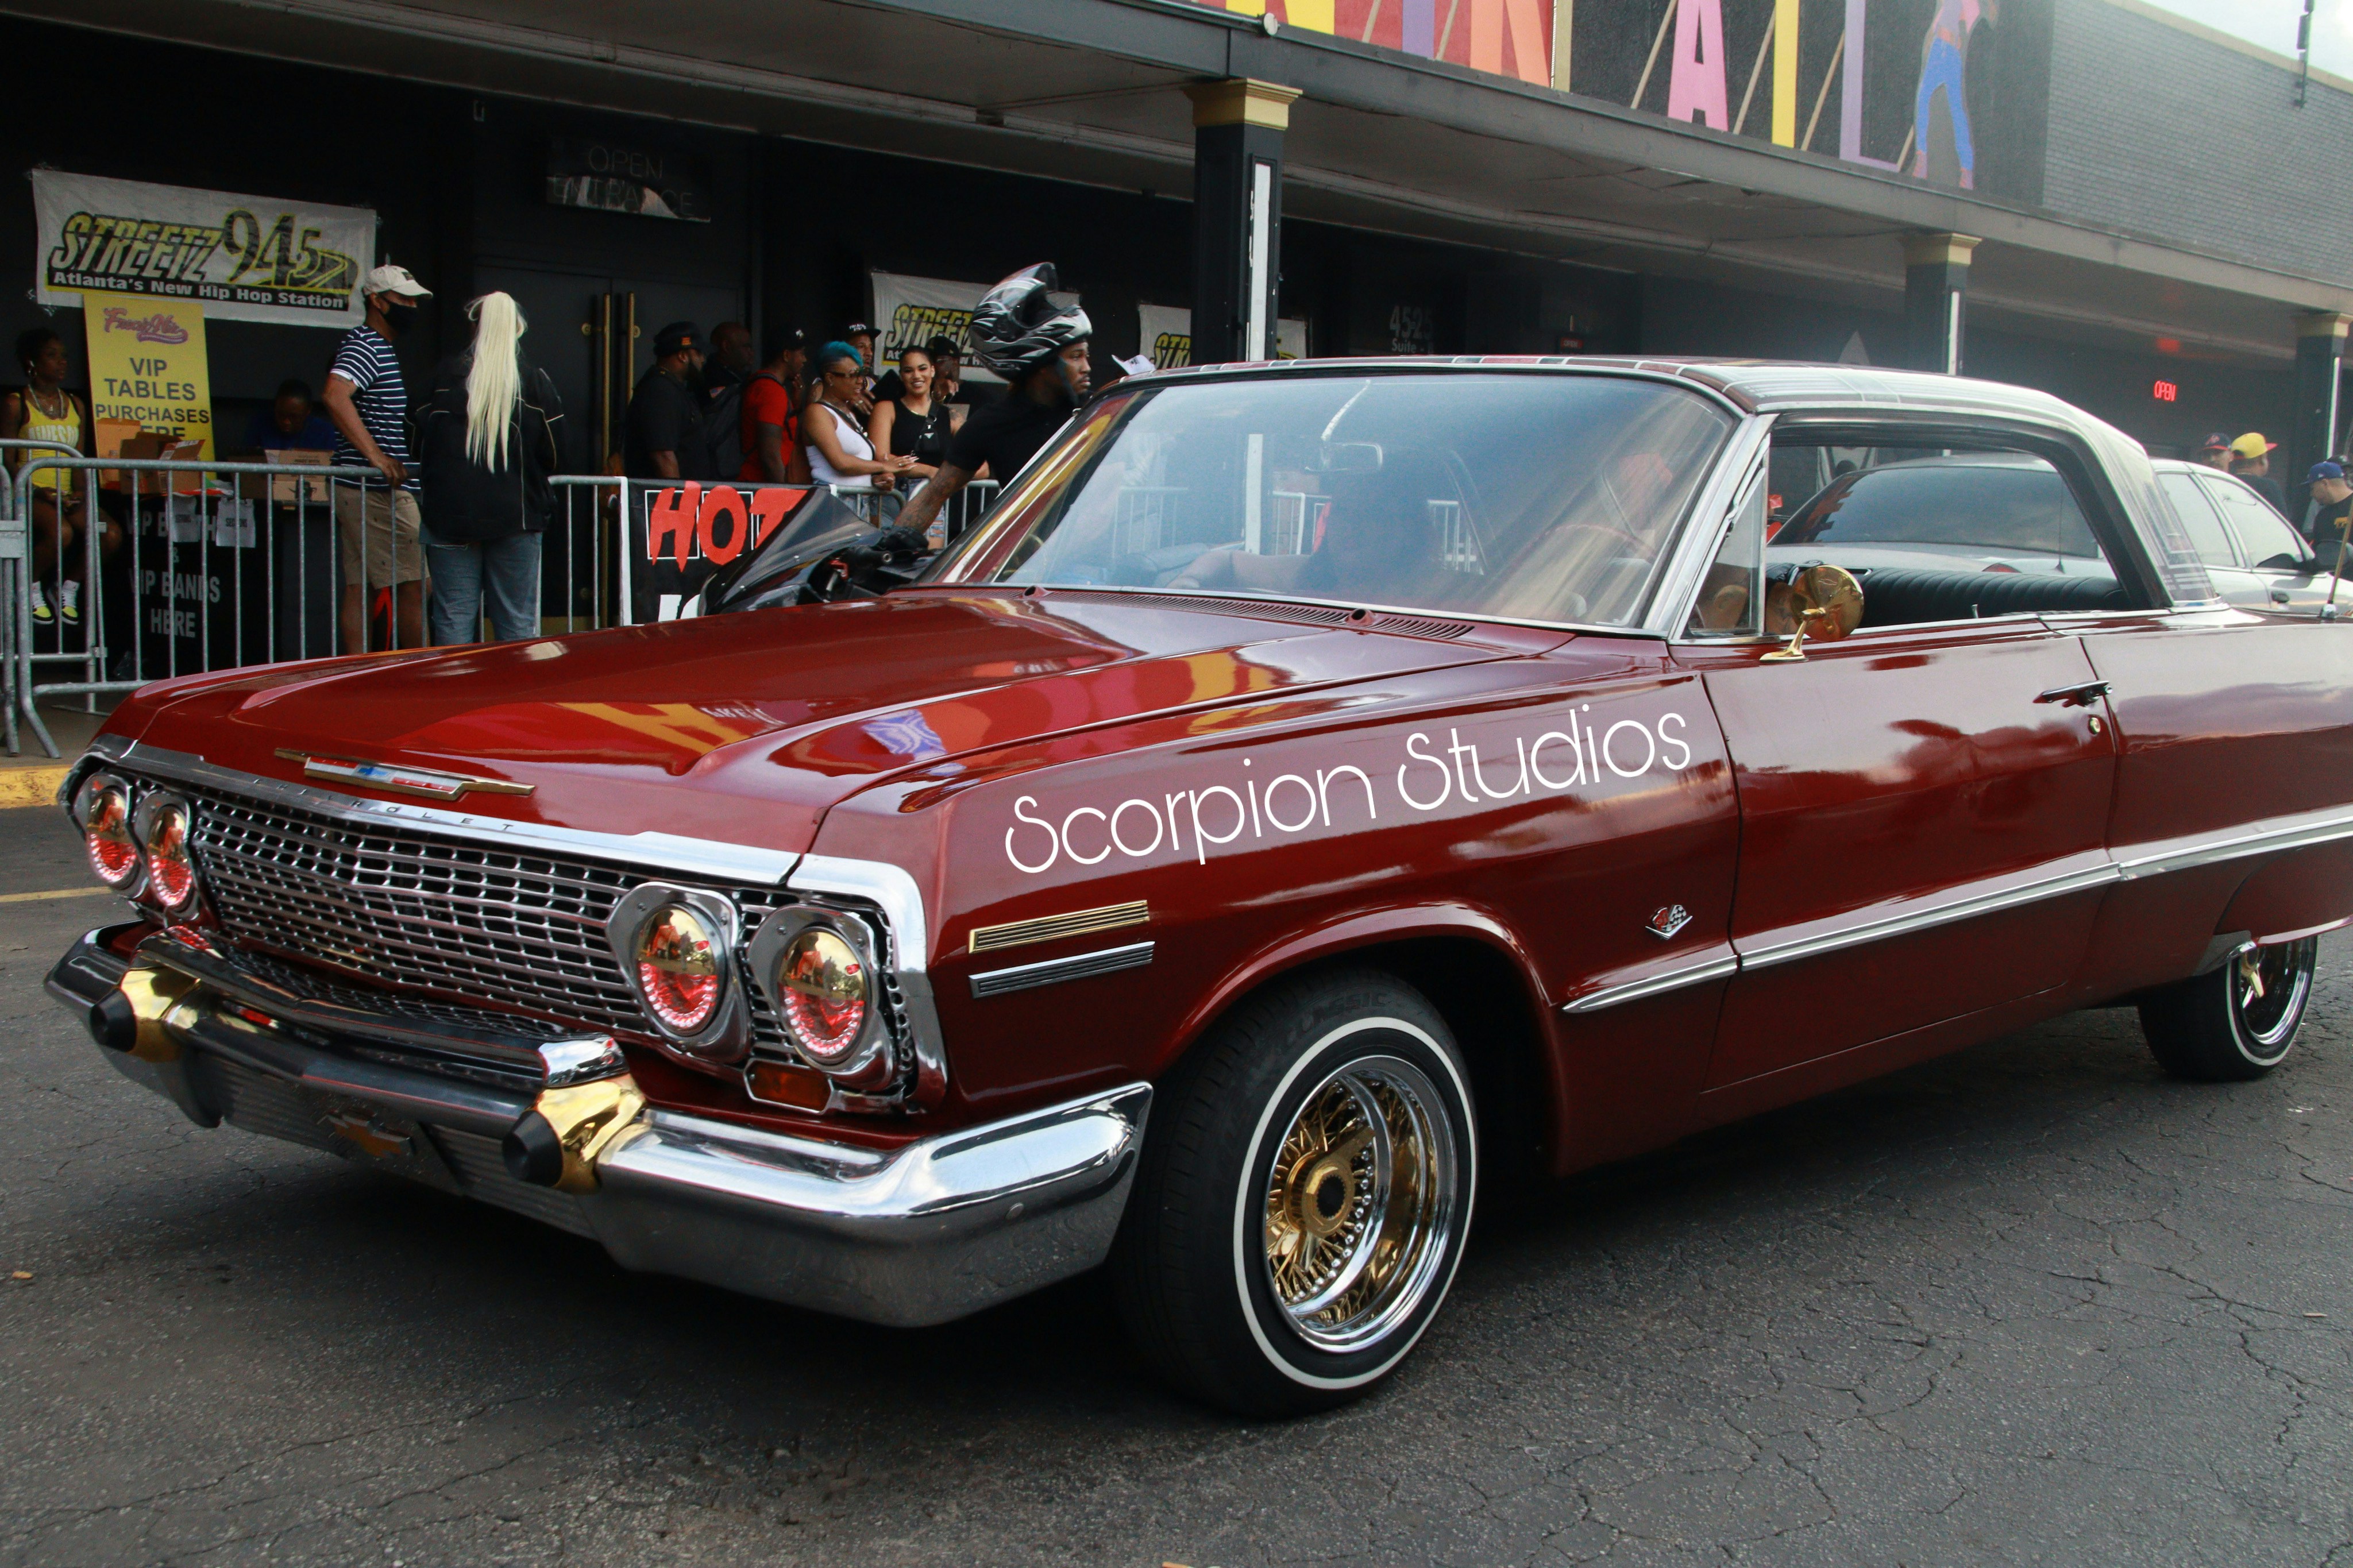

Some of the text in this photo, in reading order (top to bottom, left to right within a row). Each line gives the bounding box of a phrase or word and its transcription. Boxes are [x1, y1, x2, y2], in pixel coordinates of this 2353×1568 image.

[588, 145, 663, 179] OPEN
[553, 173, 695, 217] ENTRACE
[48, 211, 223, 283] STREETZ
[53, 272, 344, 308] Atlanta's New Hip Hop Station
[1392, 338, 1417, 354] Suite
[129, 357, 167, 377] VIP
[104, 378, 196, 401] TABLES
[2154, 380, 2177, 401] OPEN
[95, 403, 210, 424] PURCHASES
[649, 481, 808, 573] HOT
[151, 608, 196, 638] HERE
[1005, 704, 1690, 873] Scorpion Studios
